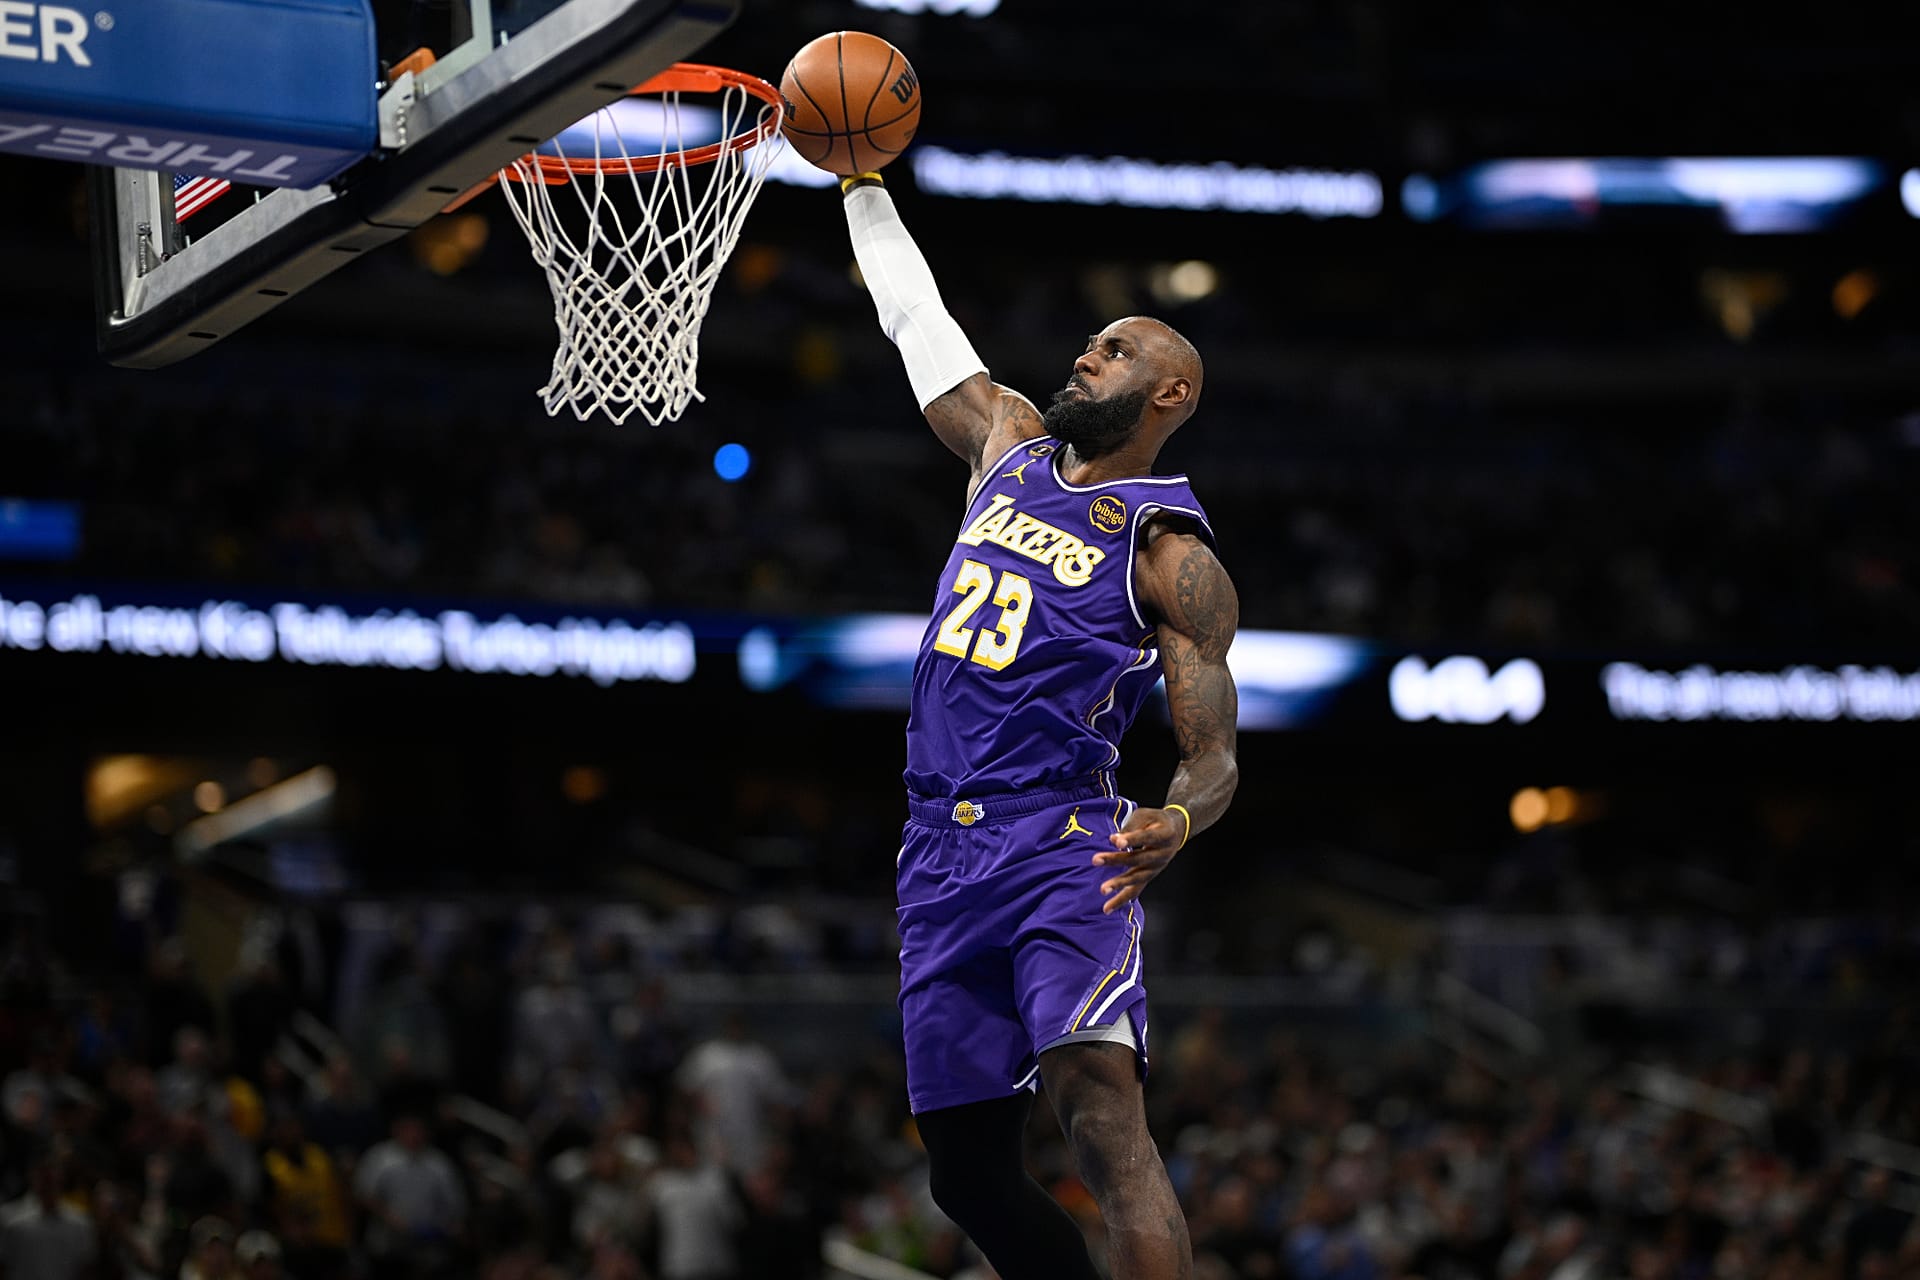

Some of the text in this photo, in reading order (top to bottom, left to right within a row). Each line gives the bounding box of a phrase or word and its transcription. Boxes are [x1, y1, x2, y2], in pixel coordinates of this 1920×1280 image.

[957, 493, 1106, 587] LAKERS
[1094, 501, 1124, 525] bibigo
[933, 558, 1033, 671] 23
